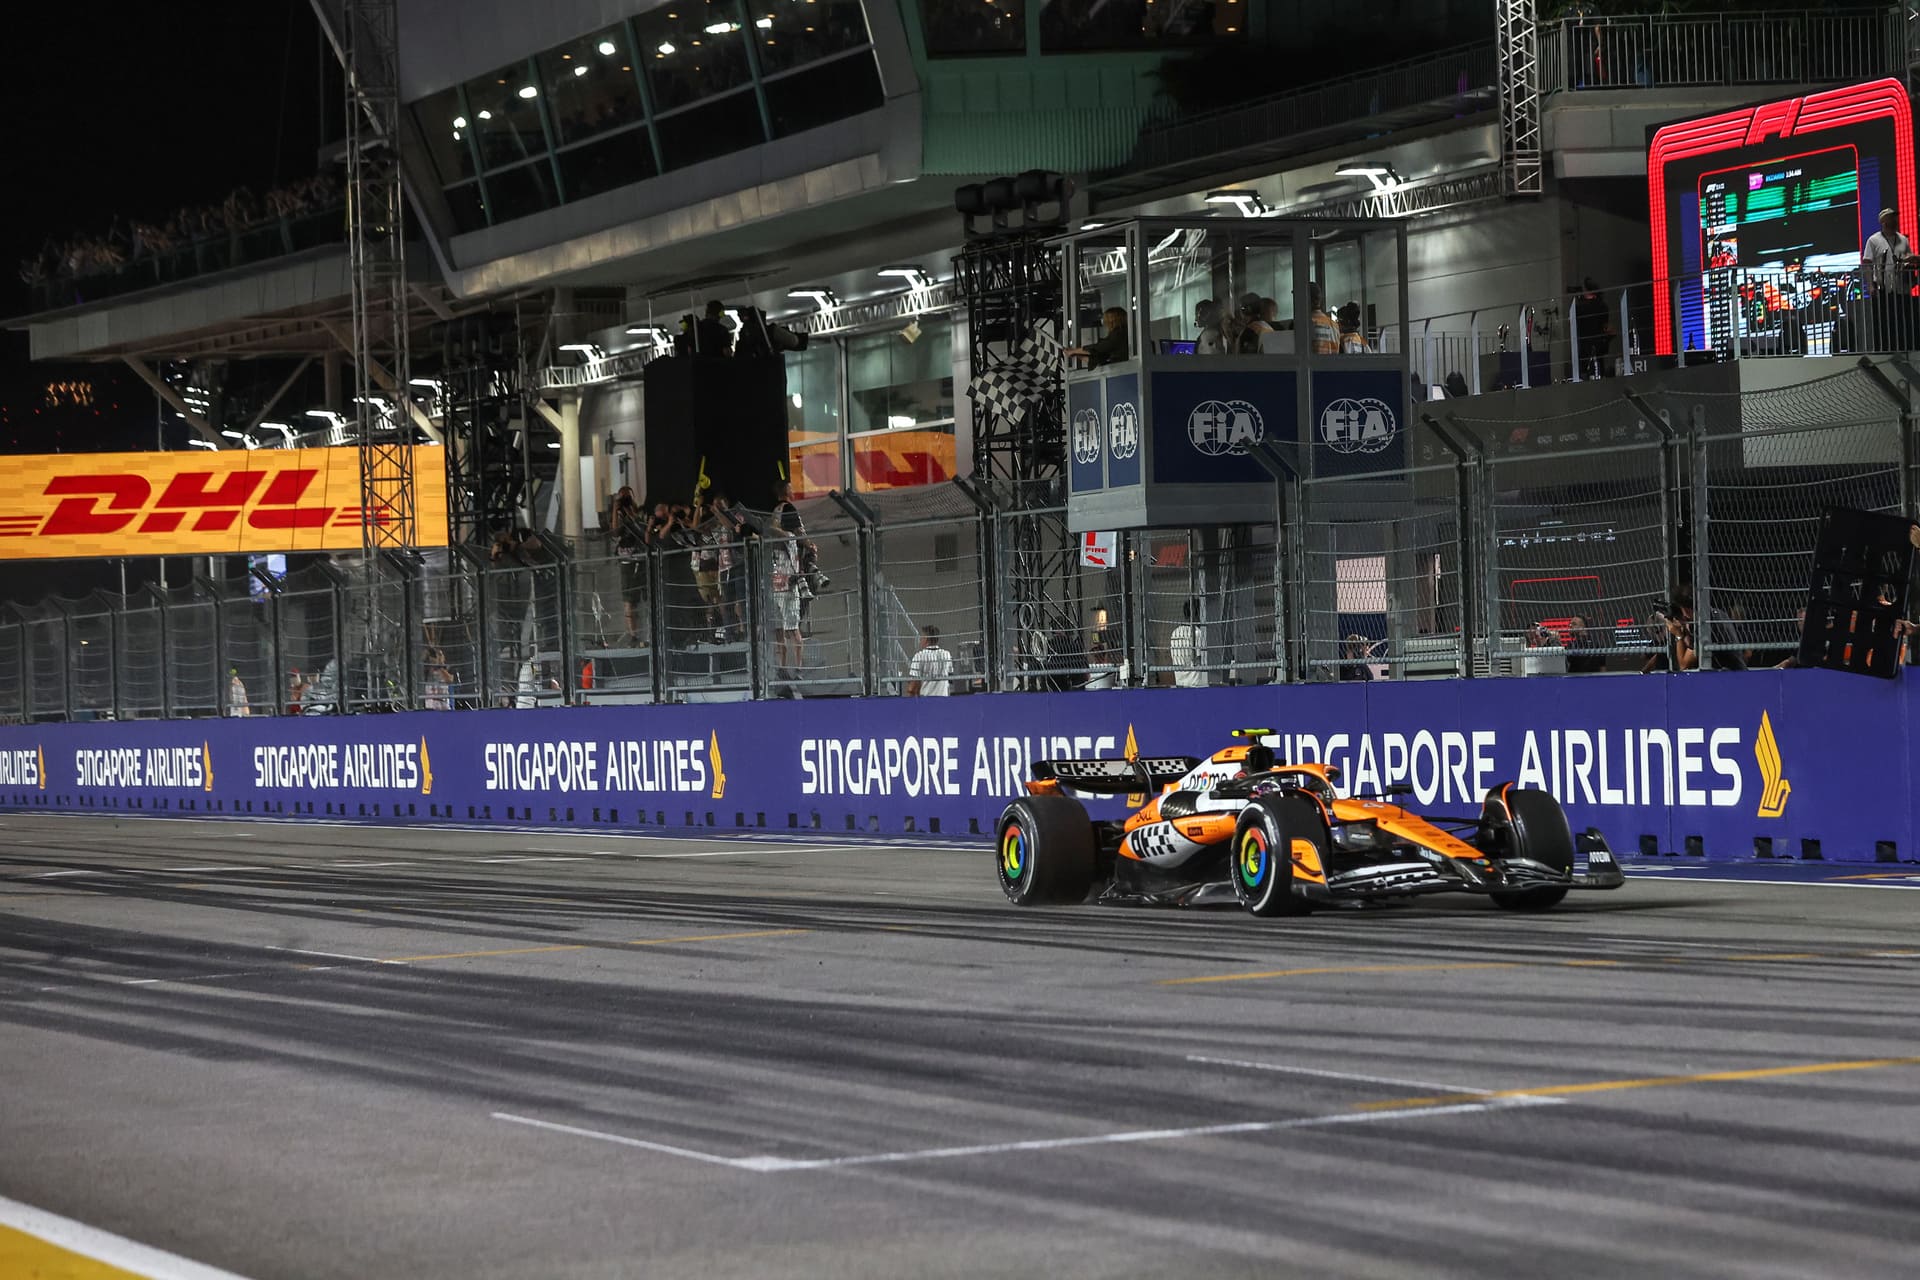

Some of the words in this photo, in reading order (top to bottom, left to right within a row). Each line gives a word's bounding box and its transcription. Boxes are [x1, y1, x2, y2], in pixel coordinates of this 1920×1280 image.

[40, 470, 335, 535] DHL
[0, 750, 38, 785] IRLINES
[76, 748, 142, 787] SINGAPORE
[145, 747, 203, 786] AIRLINES
[254, 744, 338, 789] SINGAPORE
[344, 743, 418, 788] AIRLINES
[485, 740, 598, 793] SINGAPORE
[605, 740, 706, 792] AIRLINES
[801, 736, 961, 797] SINGAPORE
[1518, 727, 1742, 806] AIRLINES
